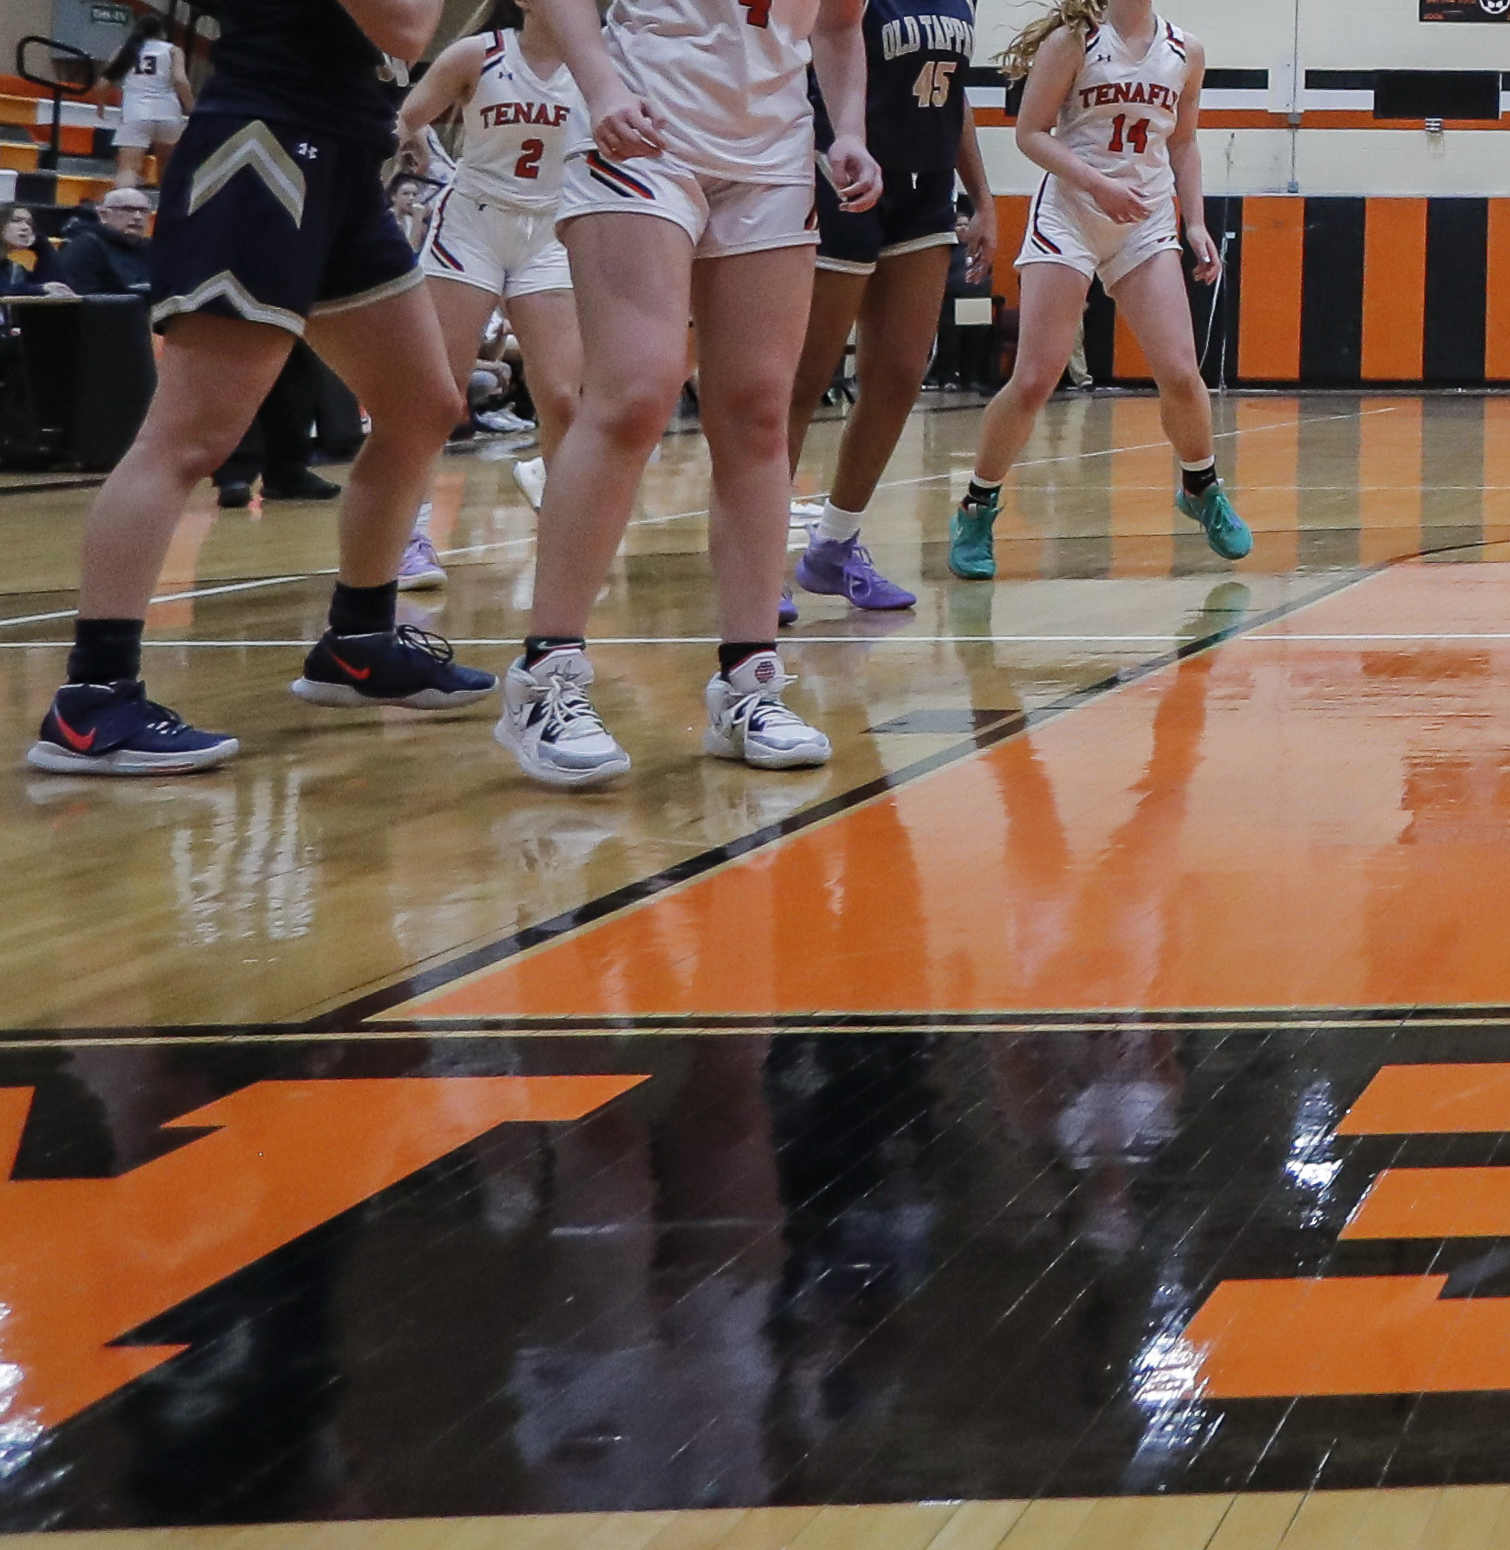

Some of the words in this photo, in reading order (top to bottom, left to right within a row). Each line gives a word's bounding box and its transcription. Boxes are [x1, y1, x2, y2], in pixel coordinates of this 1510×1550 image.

[882, 15, 920, 61] OLD
[918, 14, 974, 61] TAPPA
[912, 60, 957, 108] 45
[480, 102, 571, 129] TENAF
[1108, 113, 1150, 154] 14
[514, 138, 545, 180] 2
